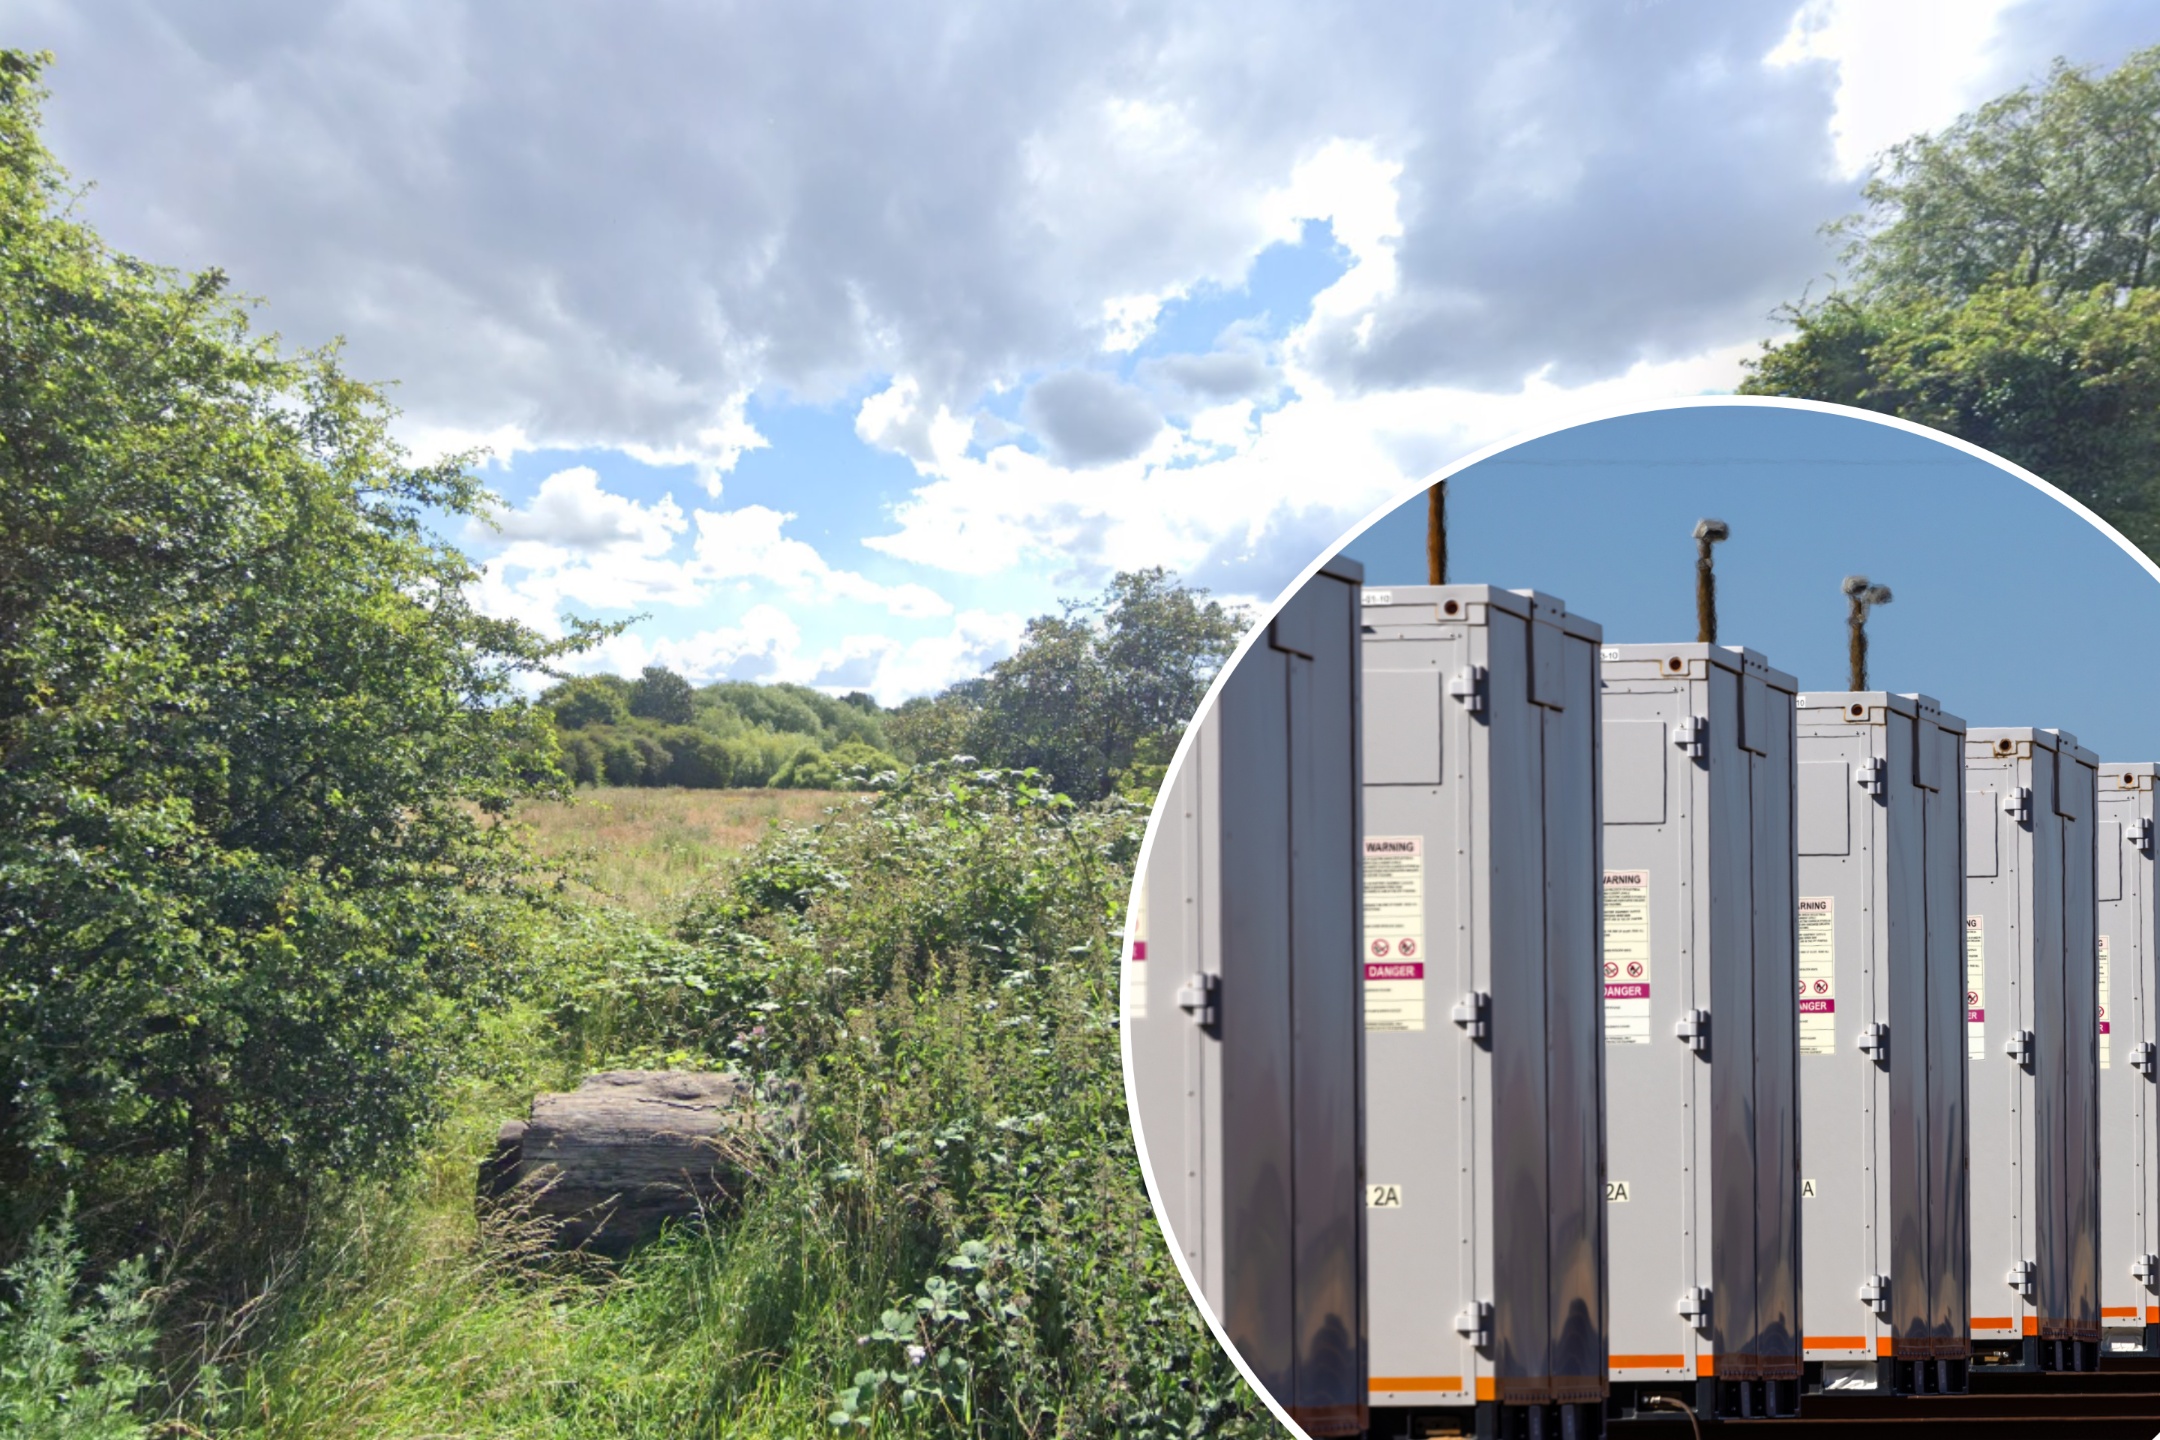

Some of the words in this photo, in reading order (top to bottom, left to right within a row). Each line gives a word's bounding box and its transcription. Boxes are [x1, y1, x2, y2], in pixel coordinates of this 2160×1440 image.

[1365, 841, 1414, 852] WARNING
[1799, 901, 1827, 910] RNING
[1368, 965, 1415, 977] DANGER
[1373, 1186, 1399, 1206] 2A
